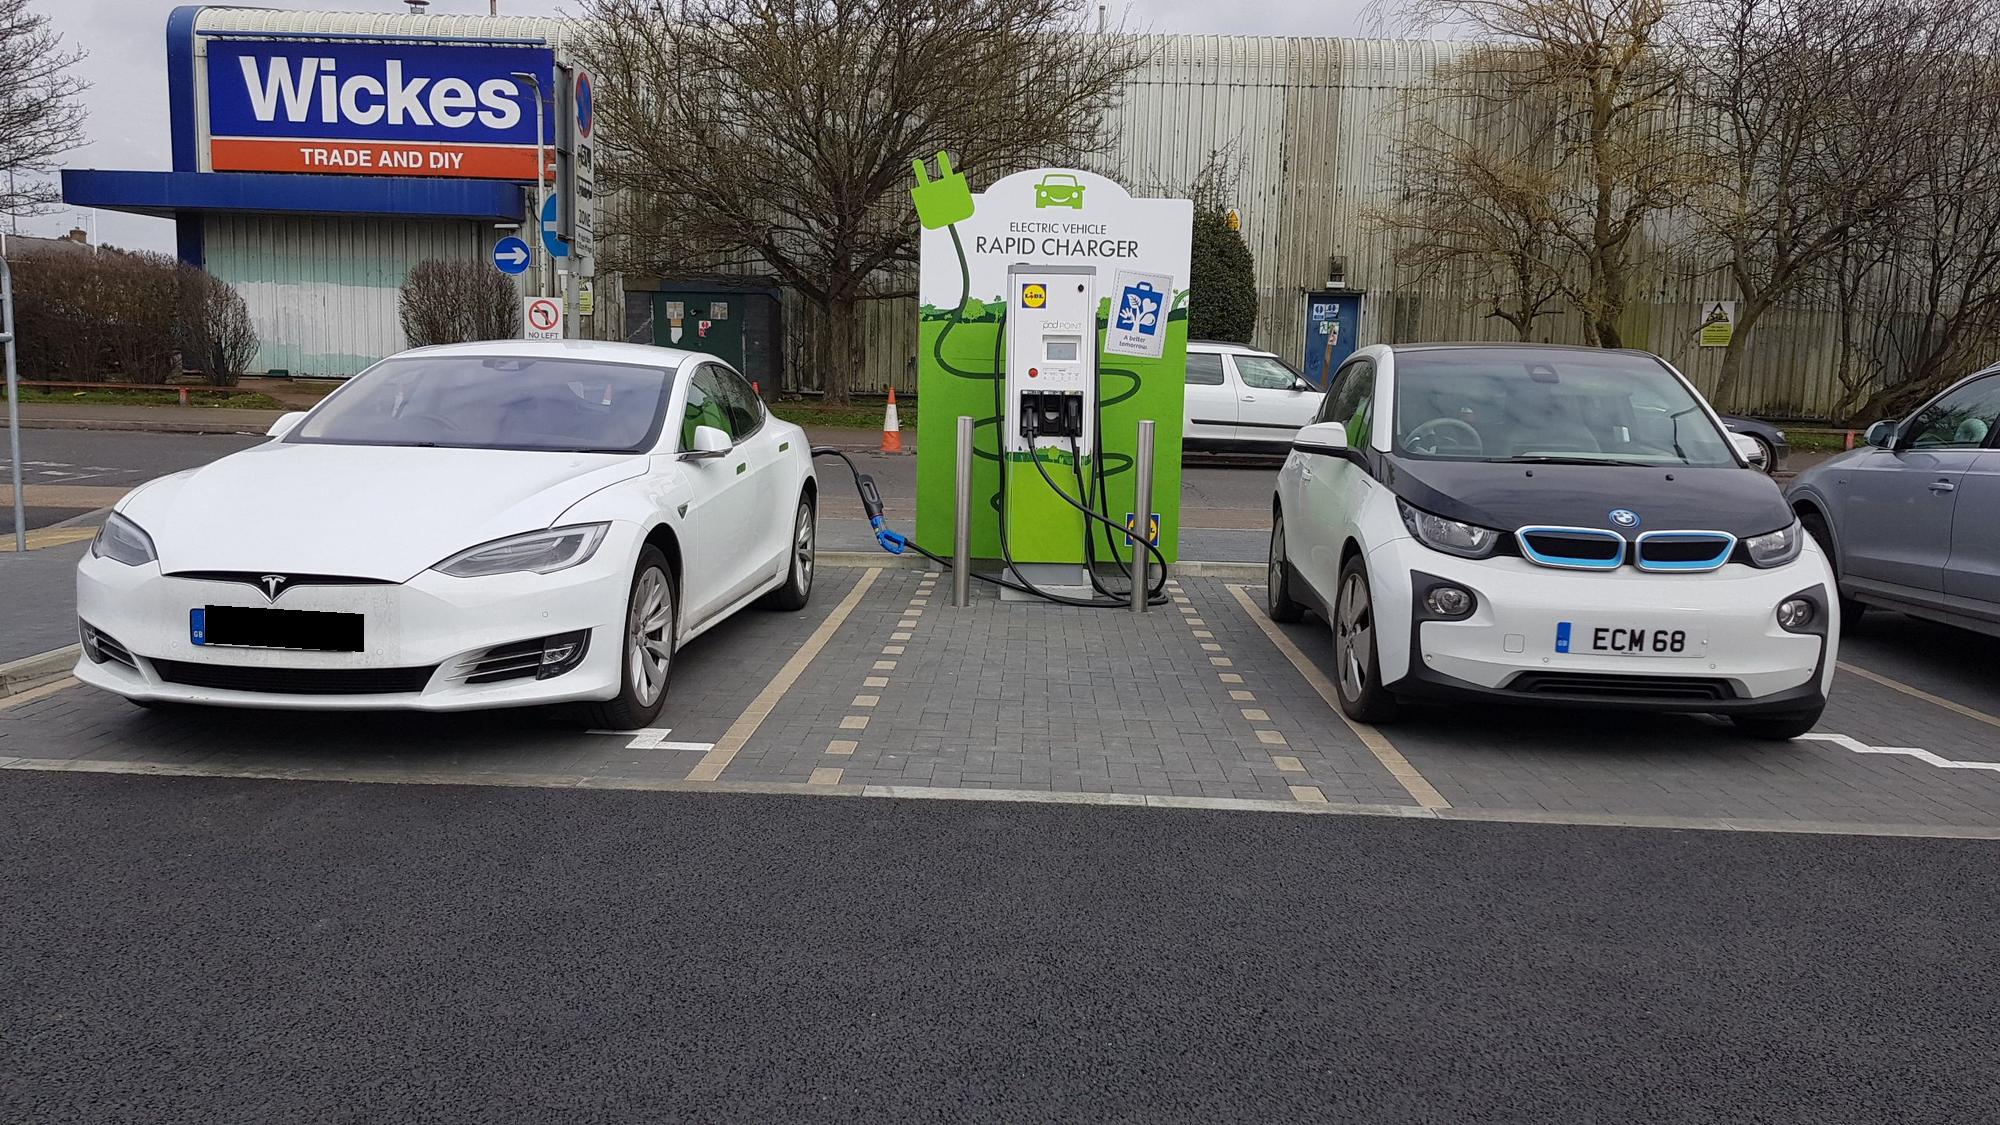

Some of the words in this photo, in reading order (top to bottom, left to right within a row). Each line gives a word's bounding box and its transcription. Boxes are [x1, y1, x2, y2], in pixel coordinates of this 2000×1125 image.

[239, 56, 521, 129] Wickes
[300, 148, 372, 167] TRADE
[379, 151, 423, 168] AND
[430, 152, 464, 170] DIY
[578, 208, 591, 228] ZONE
[1009, 221, 1059, 234] ELECTRIC
[1062, 223, 1107, 235] VEHICLE
[976, 236, 1036, 255] RAPID
[1041, 238, 1139, 258] CHARGER
[1059, 322, 1082, 330] POINT
[193, 630, 203, 638] GB
[1592, 627, 1646, 652] ECM
[1652, 630, 1686, 653] 68
